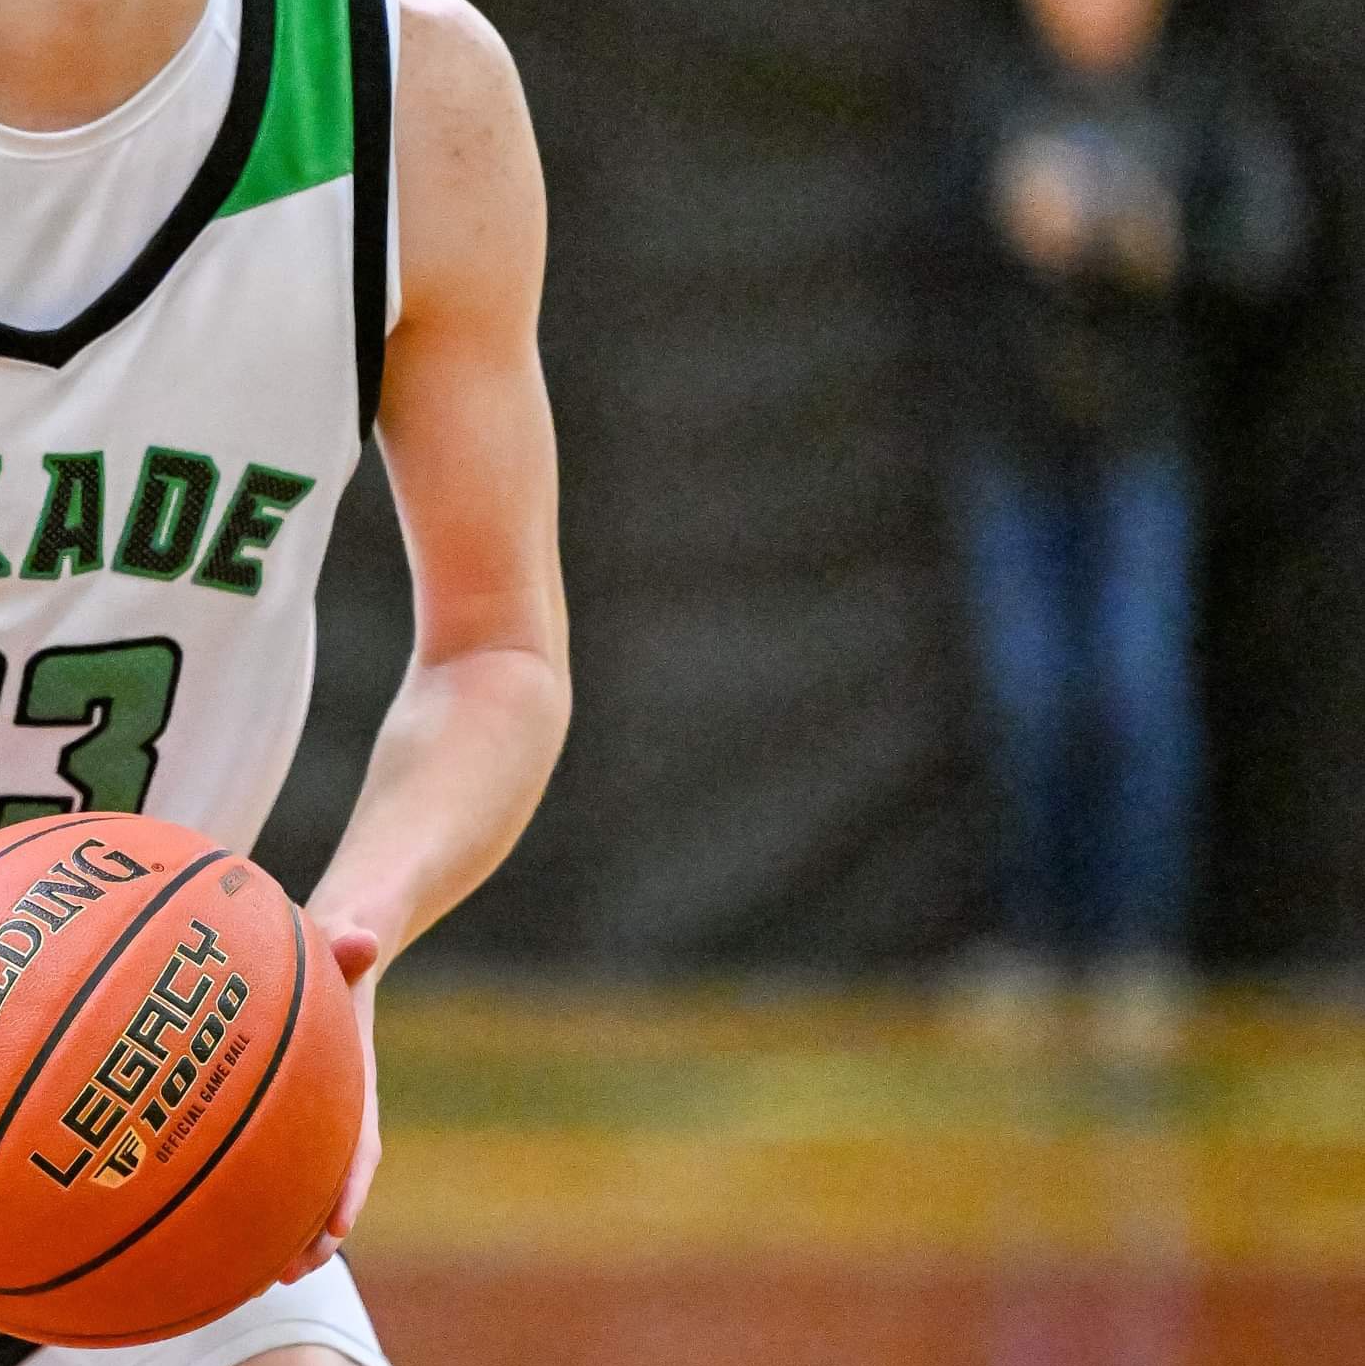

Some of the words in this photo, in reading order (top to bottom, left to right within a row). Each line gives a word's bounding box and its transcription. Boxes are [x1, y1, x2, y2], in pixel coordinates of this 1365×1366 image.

[29, 918, 227, 1188] LEGACY
[92, 1129, 140, 1179] TF
[138, 971, 250, 1137] 1000
[155, 1104, 206, 1164] OFFICIAL
[200, 1063, 231, 1103] GAME
[224, 1033, 251, 1067] BALL
